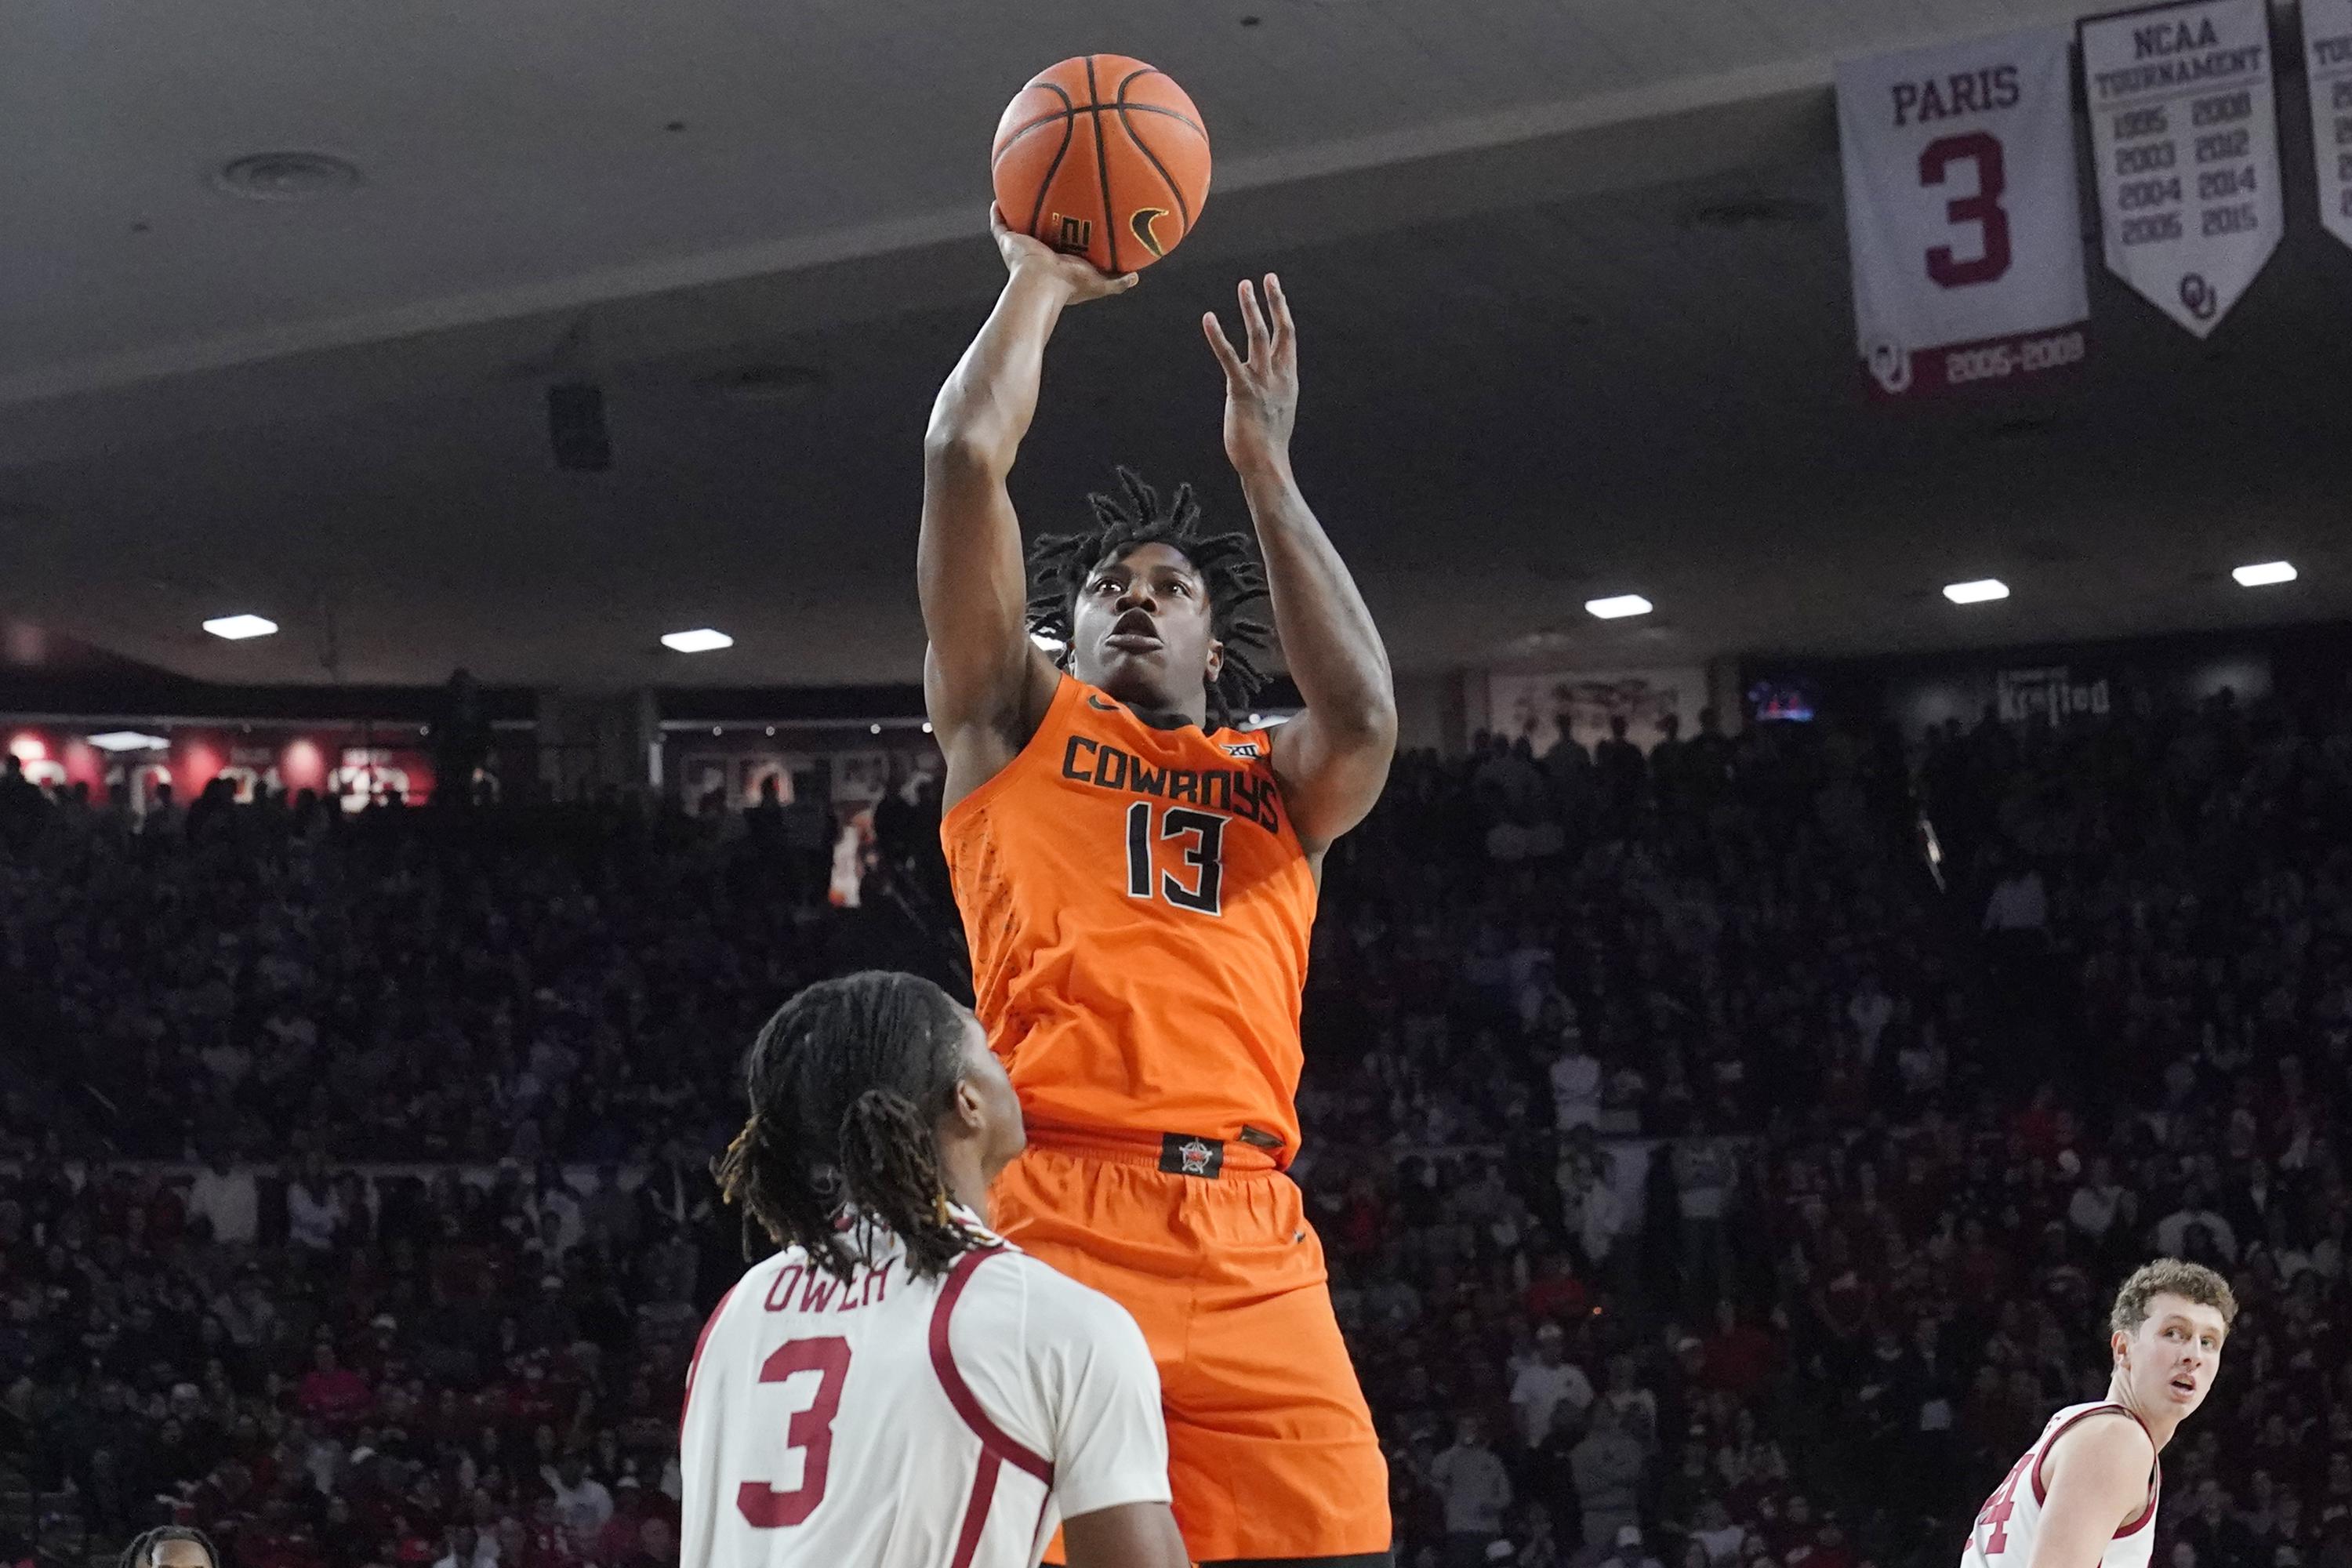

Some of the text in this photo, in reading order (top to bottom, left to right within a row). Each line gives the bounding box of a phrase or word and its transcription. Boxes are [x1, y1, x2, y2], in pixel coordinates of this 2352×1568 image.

[2095, 45, 2262, 99] TOURNAMENT
[2134, 18, 2218, 60] NCAA
[1891, 65, 2021, 126] PARIS
[1918, 129, 2013, 290] 3
[1062, 735, 1280, 835] COWBOYS
[1126, 800, 1233, 917] 13
[736, 1335, 852, 1530] 3
[1963, 1453, 2036, 1555] 4
